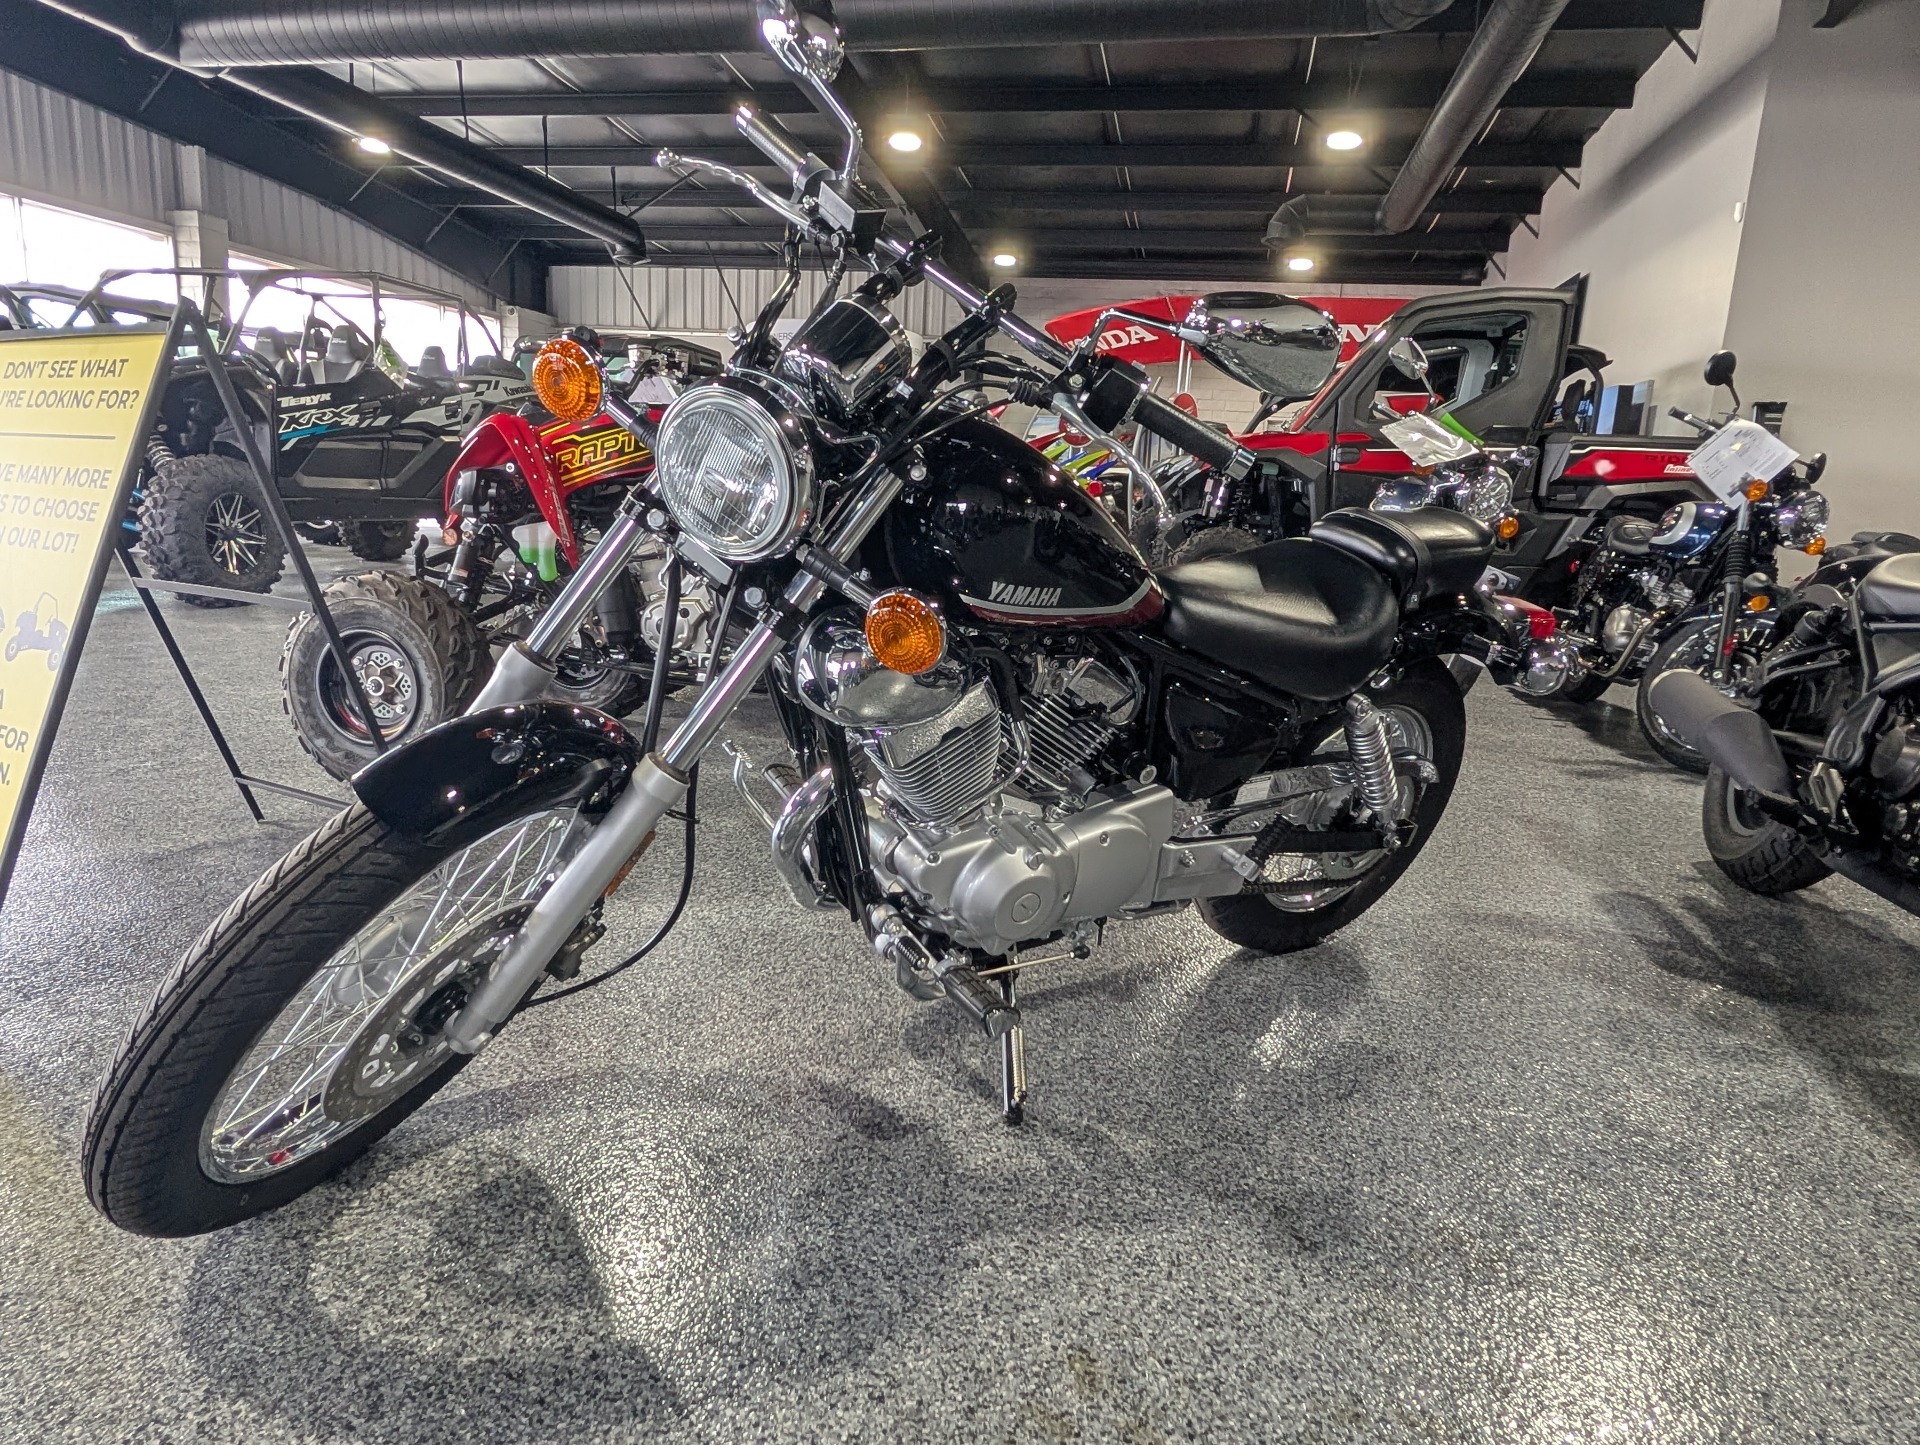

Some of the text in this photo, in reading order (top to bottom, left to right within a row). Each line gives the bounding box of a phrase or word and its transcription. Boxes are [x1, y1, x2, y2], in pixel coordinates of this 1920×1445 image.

[1064, 325, 1159, 353] NDA
[3, 358, 129, 379] DON'T SEE WHAT
[26, 389, 95, 409] LOOKING
[96, 389, 140, 410] FOR?
[556, 431, 645, 473] RAPT
[16, 464, 63, 486] MANY
[62, 467, 112, 490] MORE
[10, 494, 31, 515] TO
[32, 497, 100, 522] CHOOSE
[7, 526, 42, 549] OUR
[42, 530, 80, 554] LOT!
[988, 580, 1063, 607] YAMAHA
